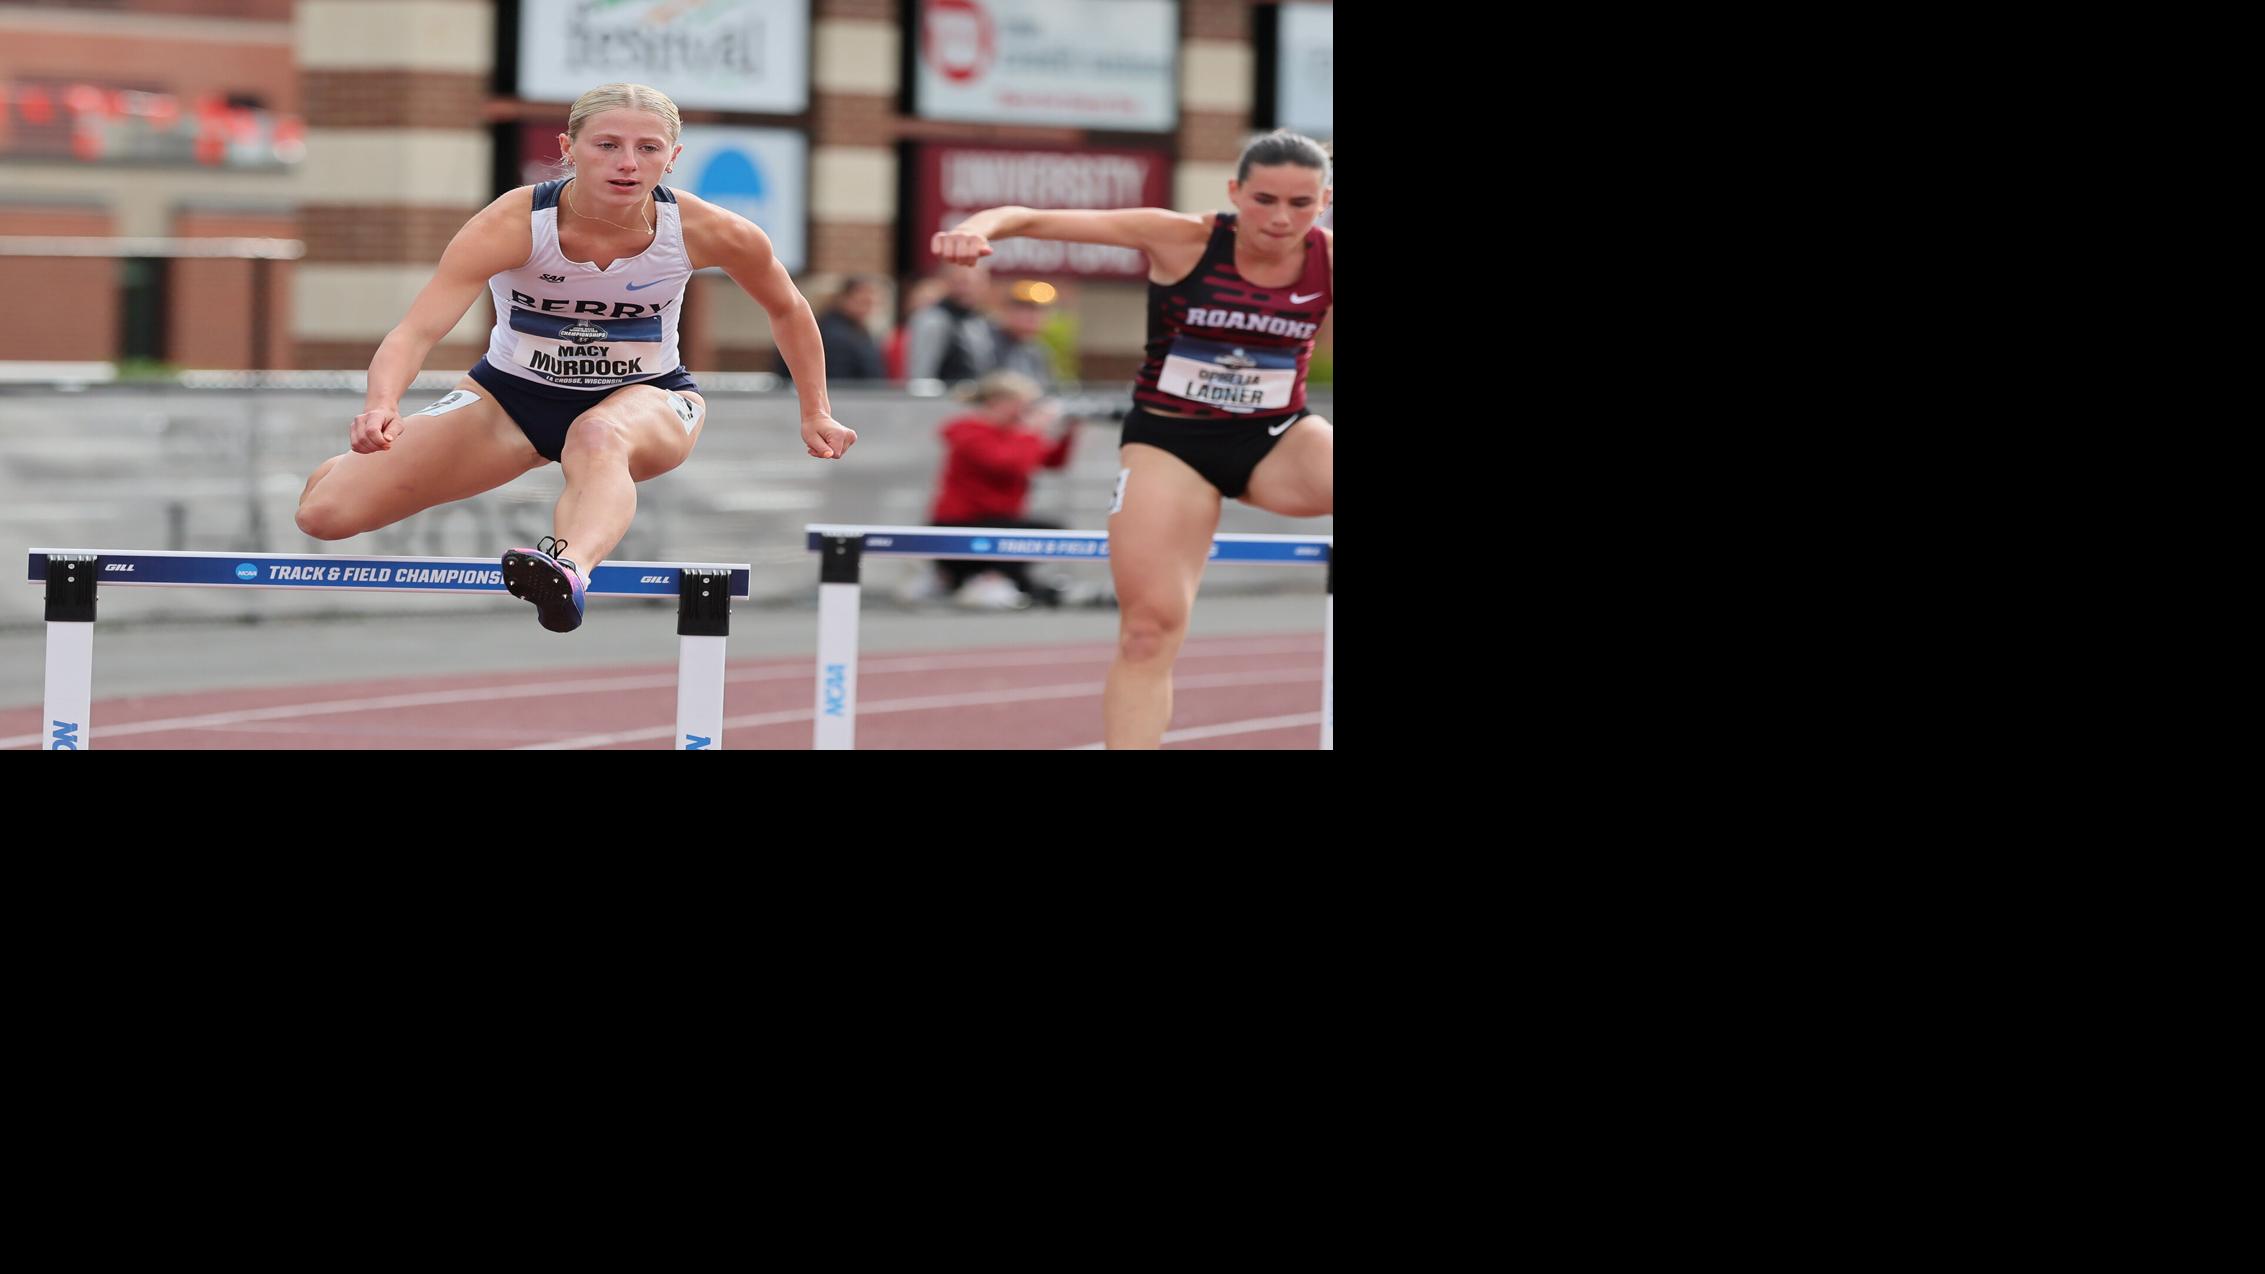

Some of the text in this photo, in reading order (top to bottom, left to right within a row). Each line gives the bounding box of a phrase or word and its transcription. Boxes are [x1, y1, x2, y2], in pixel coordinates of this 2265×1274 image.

[543, 273, 565, 283] SAA
[1185, 308, 1317, 339] ROANOKE
[558, 345, 610, 357] MACY
[529, 350, 643, 376] MURDOCK
[104, 563, 136, 572] GILL
[269, 565, 504, 585] TRACK & FIELD CHAMPIONS
[640, 575, 671, 584] GILL
